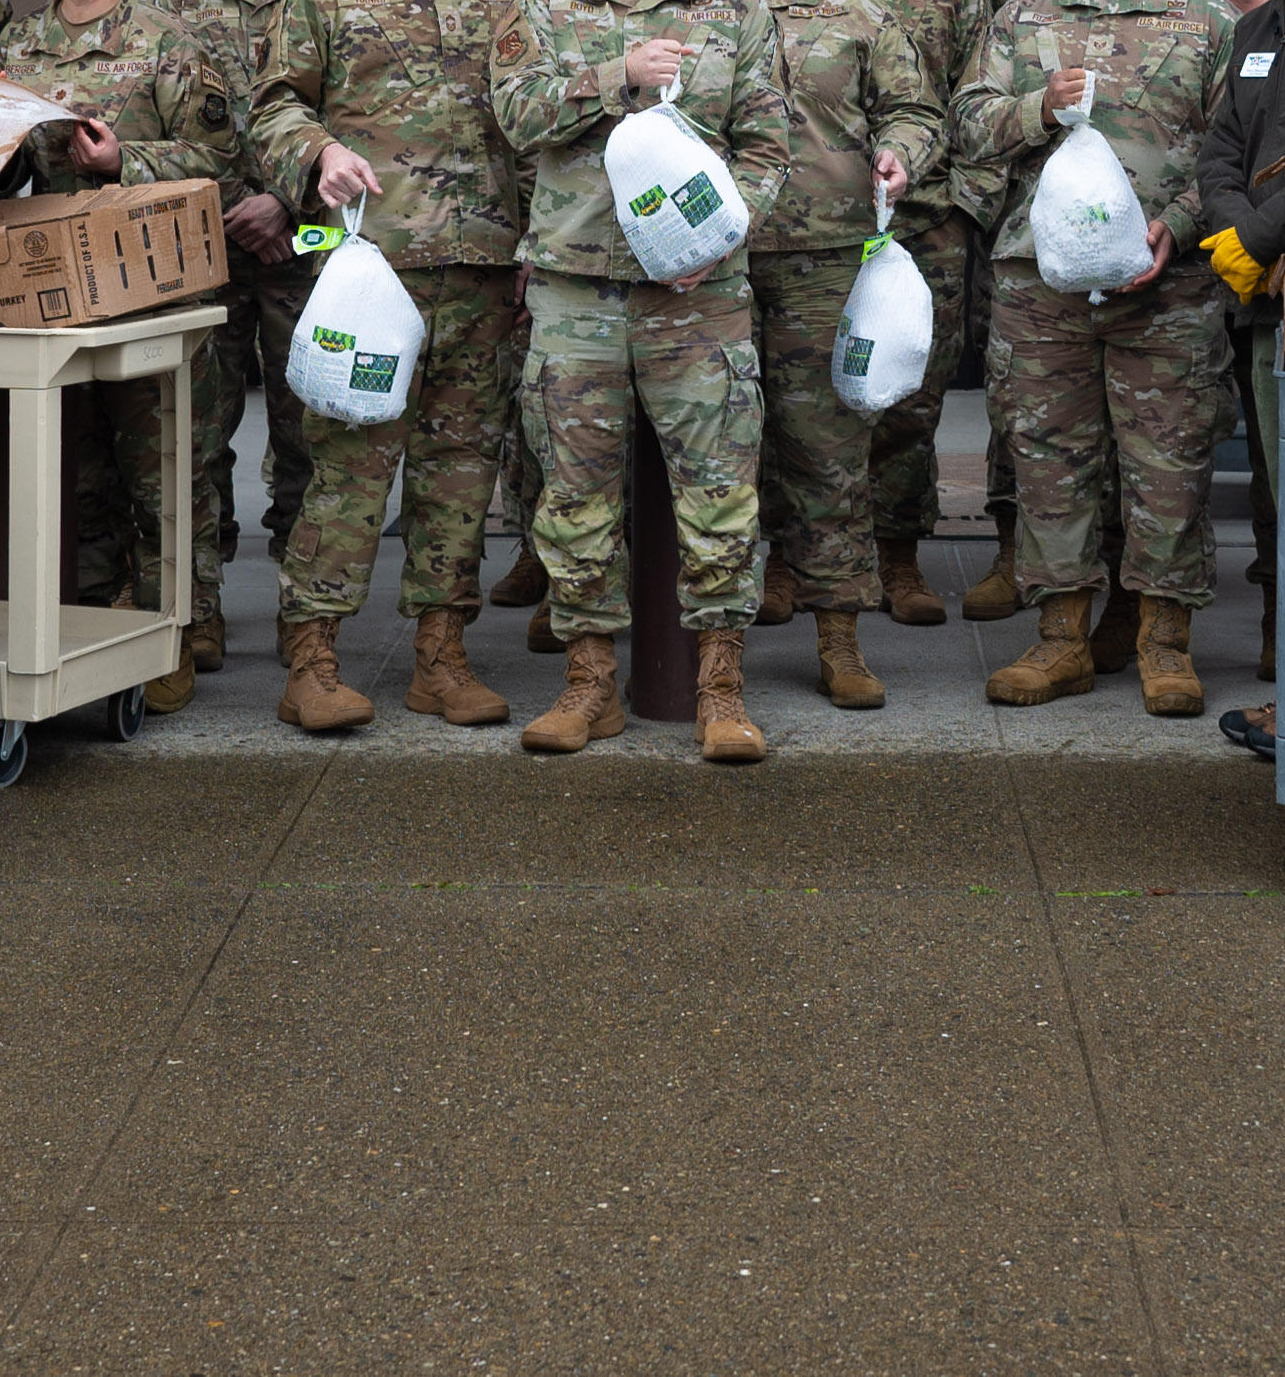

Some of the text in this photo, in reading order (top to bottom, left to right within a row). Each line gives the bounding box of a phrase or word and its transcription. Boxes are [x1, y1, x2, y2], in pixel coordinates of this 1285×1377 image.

[1155, 20, 1171, 30] AIR
[1172, 22, 1202, 33] FORCE
[112, 62, 126, 73] AIR
[127, 61, 153, 73] FORCE
[77, 221, 99, 305] PRODUCT OF U.S.A.
